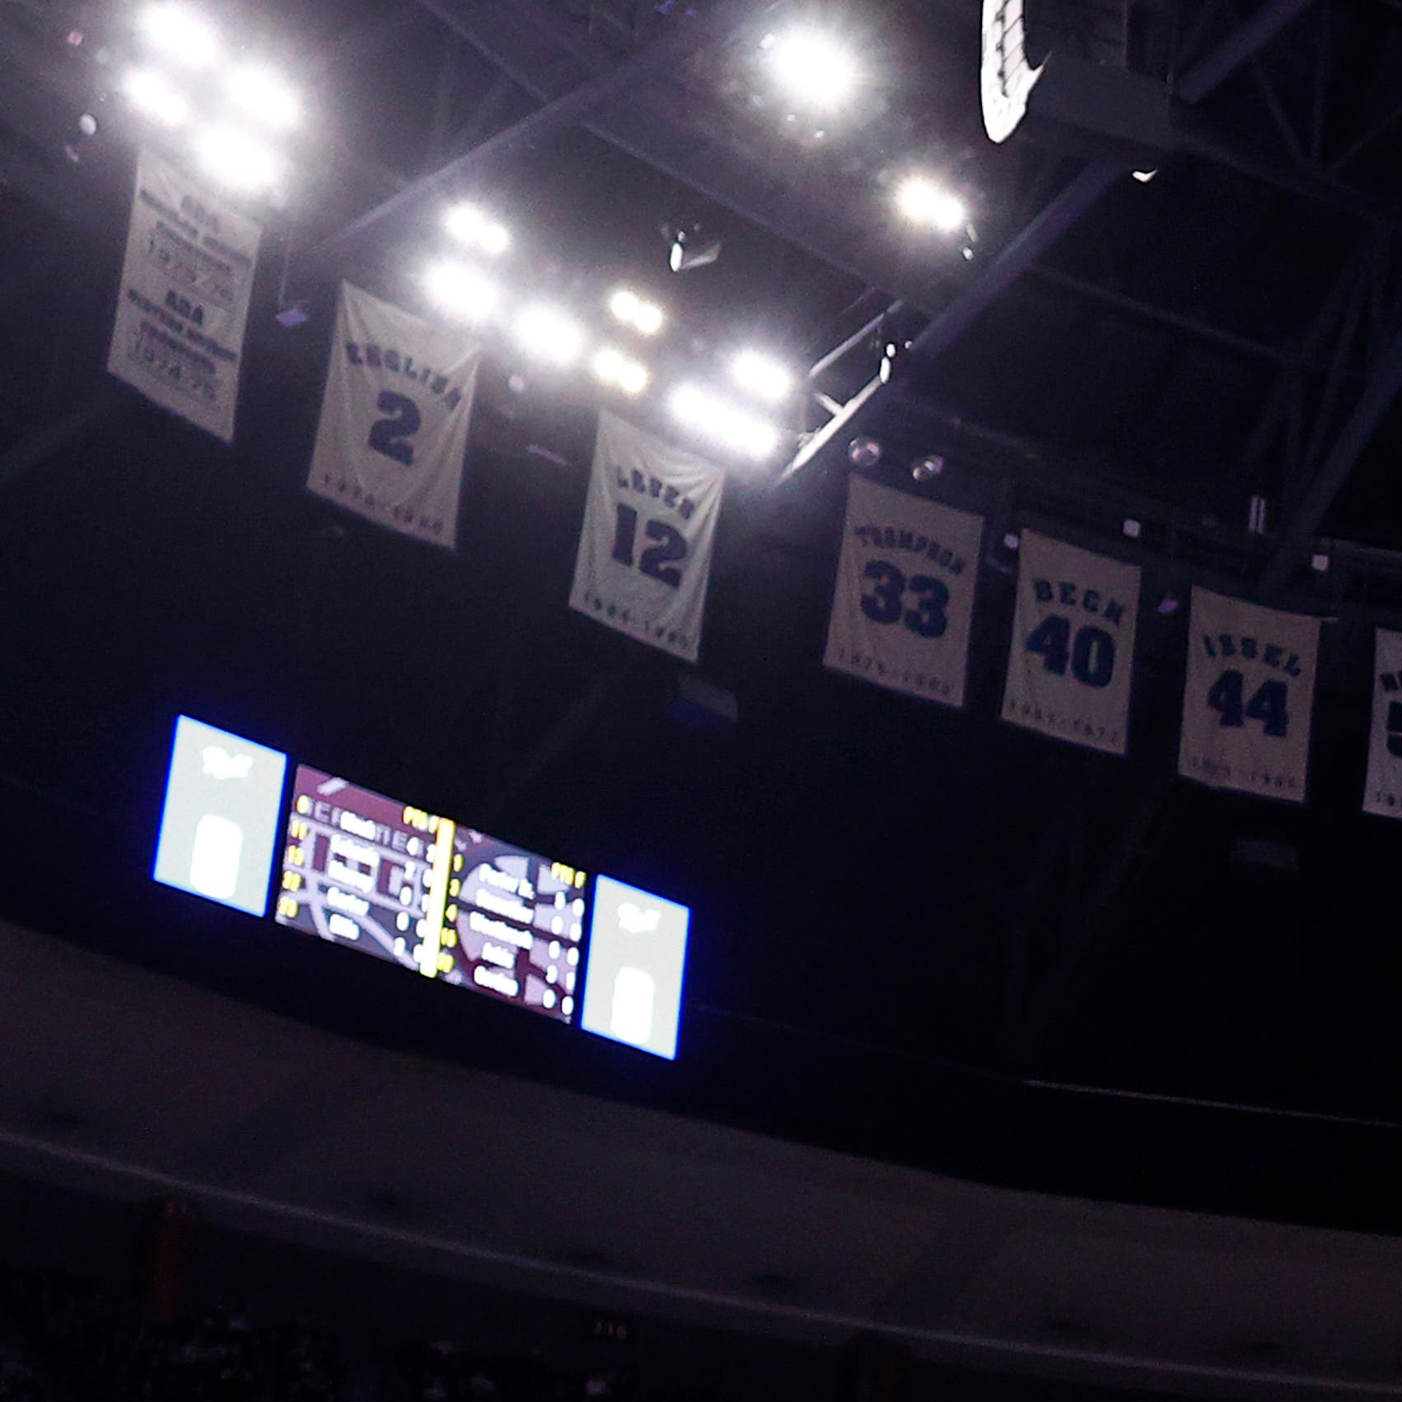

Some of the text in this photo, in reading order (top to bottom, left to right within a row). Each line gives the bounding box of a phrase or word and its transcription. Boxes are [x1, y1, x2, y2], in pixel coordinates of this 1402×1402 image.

[368, 390, 421, 467] 2
[612, 503, 687, 589] 12
[860, 559, 949, 638] 33
[1026, 614, 1116, 688] 40
[1207, 669, 1289, 737] 44
